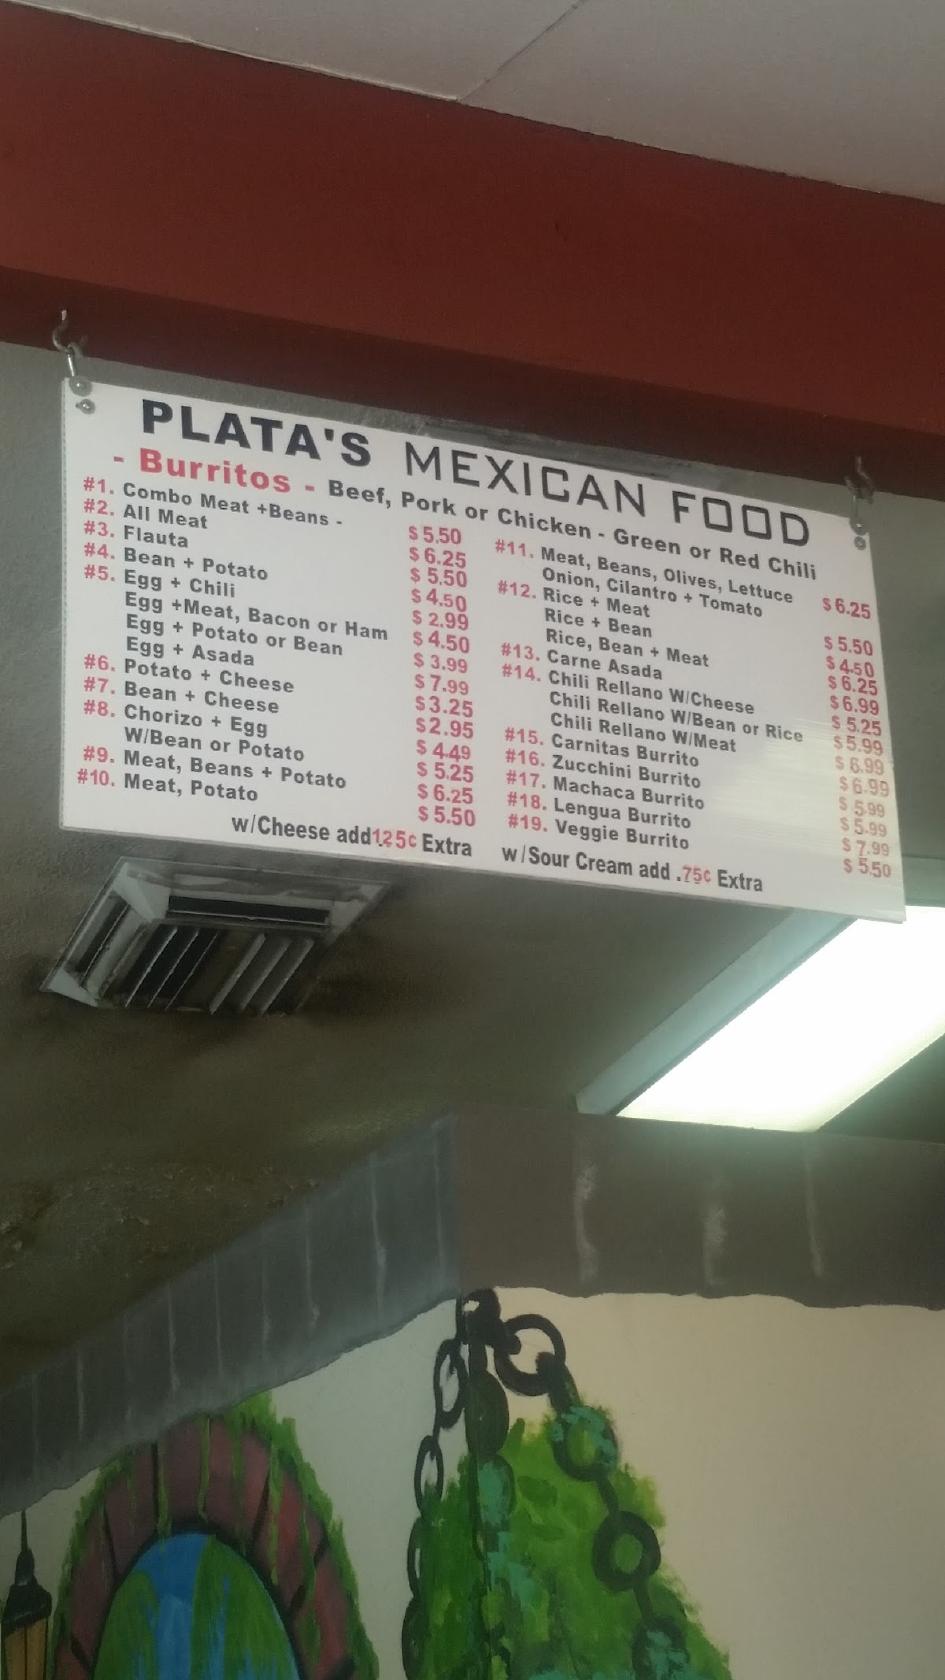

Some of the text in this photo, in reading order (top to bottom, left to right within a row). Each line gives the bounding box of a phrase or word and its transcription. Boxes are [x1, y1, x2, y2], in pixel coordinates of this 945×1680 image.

[142, 399, 810, 547] PLATA'S MEXICAN FOOD
[83, 477, 114, 494] #1.
[123, 482, 192, 505] Combo
[200, 493, 249, 514] Meat
[83, 499, 208, 529] #2. All Meat
[140, 448, 816, 580] Burritos Beef, Pork or Chicken Green or Red Chili
[84, 521, 189, 548] #3. Flauta
[84, 543, 115, 559] #4.
[124, 547, 175, 568] Bean
[203, 559, 269, 580] Potato
[495, 539, 793, 603] #11. Meat, Beans, Olives, Lettuce
[84, 565, 115, 582] #5.
[124, 569, 162, 591] Egg
[190, 579, 236, 598] Chili
[498, 580, 536, 599] #12.
[544, 587, 583, 607] Rice
[607, 598, 651, 618] Meat
[542, 568, 600, 592] Onion,
[607, 578, 677, 602] Cilantro
[700, 594, 763, 618] Tomato
[125, 592, 163, 613] Egg
[248, 608, 310, 630] Bacon
[318, 619, 337, 633] or
[345, 622, 388, 640] Ham
[126, 614, 165, 636] Egg
[192, 622, 259, 644] Potato
[266, 635, 286, 648] or
[294, 636, 343, 655] Bean
[545, 608, 585, 627] Rice
[609, 618, 652, 637] Bean
[126, 637, 165, 658] Egg
[192, 645, 255, 666] Asada
[501, 642, 663, 680] #13. Carne Asada
[546, 629, 592, 651] Rice,
[599, 638, 643, 657] Bean
[667, 648, 709, 668] Meat
[84, 654, 115, 671] #6.
[124, 658, 192, 681] Potato
[220, 670, 295, 693] Cheese
[502, 663, 755, 714] #14. Chili Rellano W/Cheese
[84, 677, 115, 694] #7.
[124, 681, 177, 701] Bean
[205, 691, 280, 713] Cheese
[83, 700, 115, 717] #8.
[124, 704, 203, 727] Chorizo
[231, 717, 268, 738] Egg
[549, 691, 804, 743] Chili Rellano W/Bean or Rice
[550, 713, 736, 752] Chili Rellano W/Meat
[124, 727, 304, 761] W/Bean or Potato
[505, 727, 699, 767] #15. Carnitas Burrito
[77, 769, 258, 801] #10. Meat, Potato
[83, 745, 115, 763] #9.
[124, 750, 182, 774] Meat,
[190, 757, 253, 778] Beans
[281, 767, 347, 789] Potato
[505, 749, 701, 788] #16. Zucchini Burrito
[506, 770, 704, 810] #17. Machaca Burrito
[507, 791, 692, 828] #18. Lengua Burrito
[232, 815, 473, 857] w/Cheese add Extra
[508, 813, 689, 850] #19. Veggie Burrito
[576, 851, 632, 876] Cream
[639, 860, 670, 880] add
[717, 869, 763, 892] Extra
